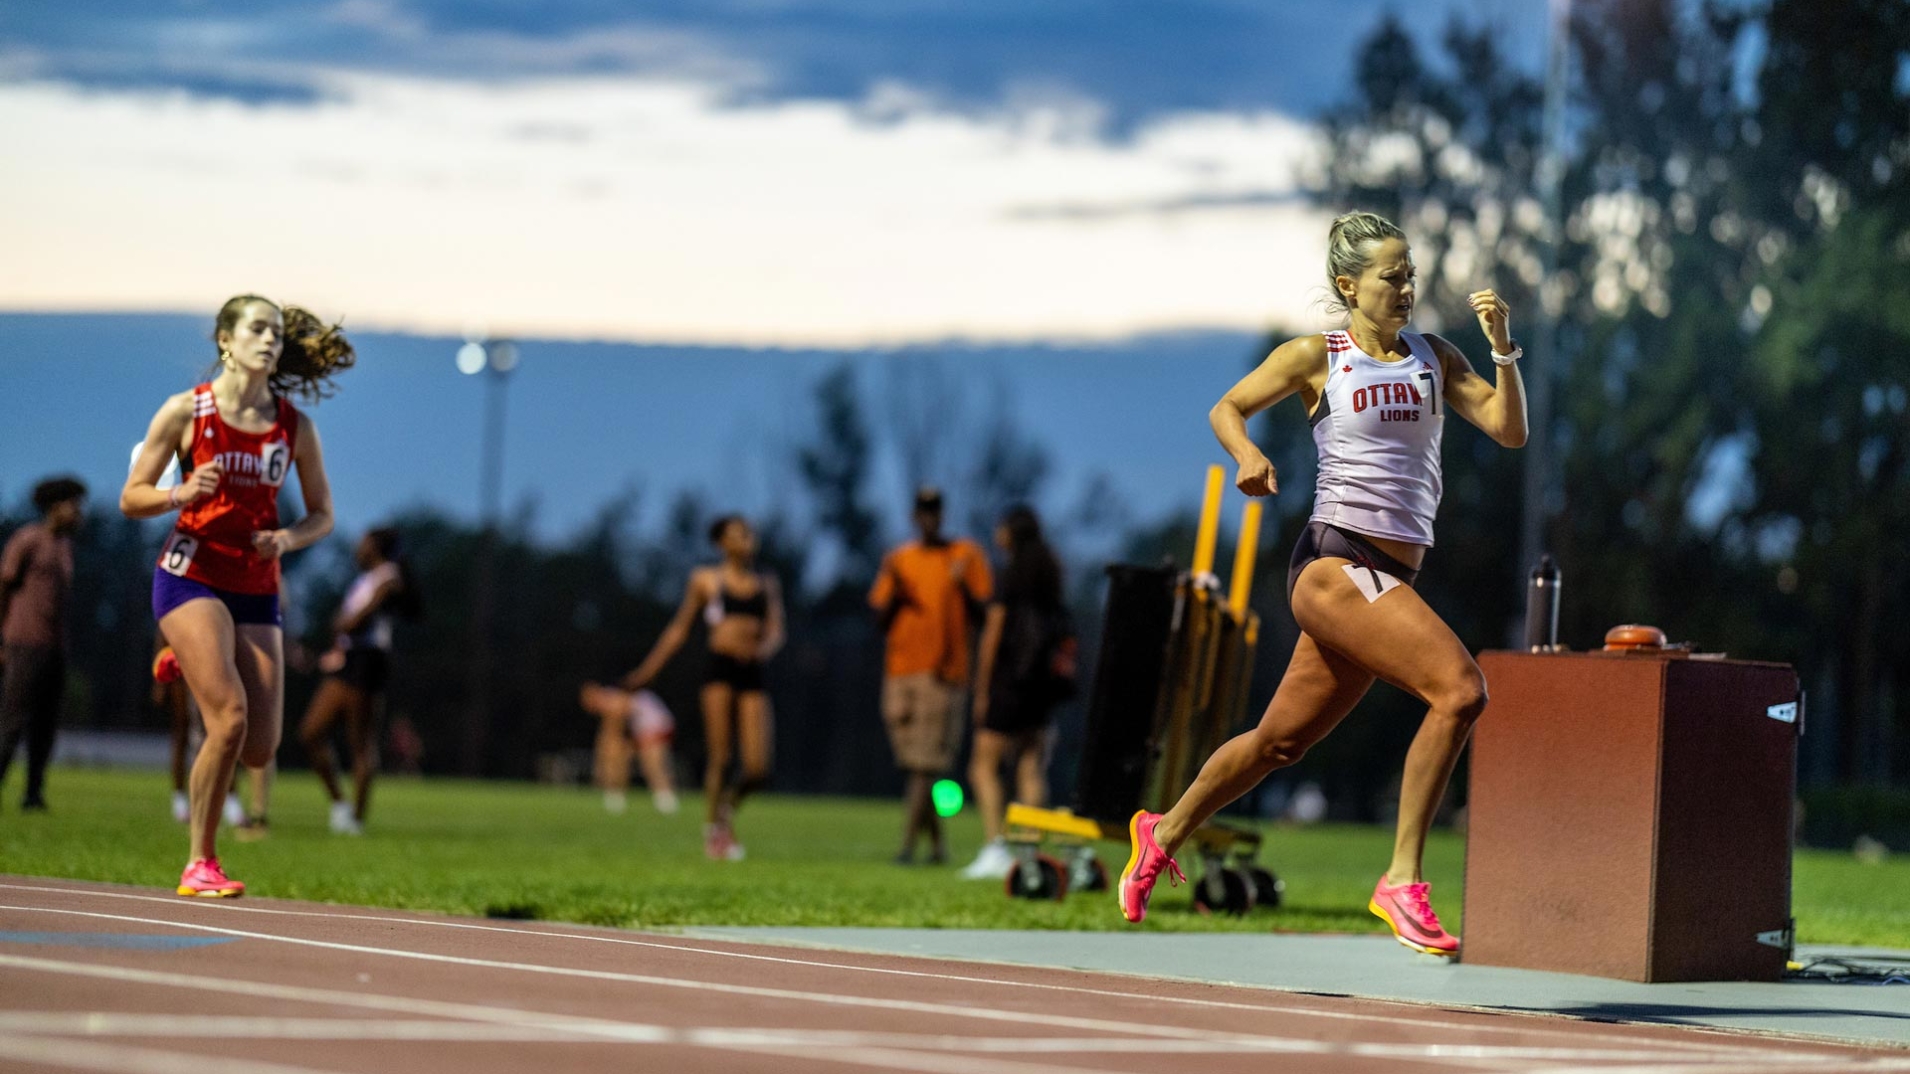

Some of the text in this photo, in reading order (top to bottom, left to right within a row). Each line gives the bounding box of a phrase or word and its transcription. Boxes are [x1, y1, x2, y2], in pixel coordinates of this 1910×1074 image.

[1353, 383, 1423, 413] OTTAW
[1418, 373, 1436, 415] 7
[1380, 409, 1420, 422] LIONS
[269, 449, 284, 482] 6
[169, 539, 191, 569] 6
